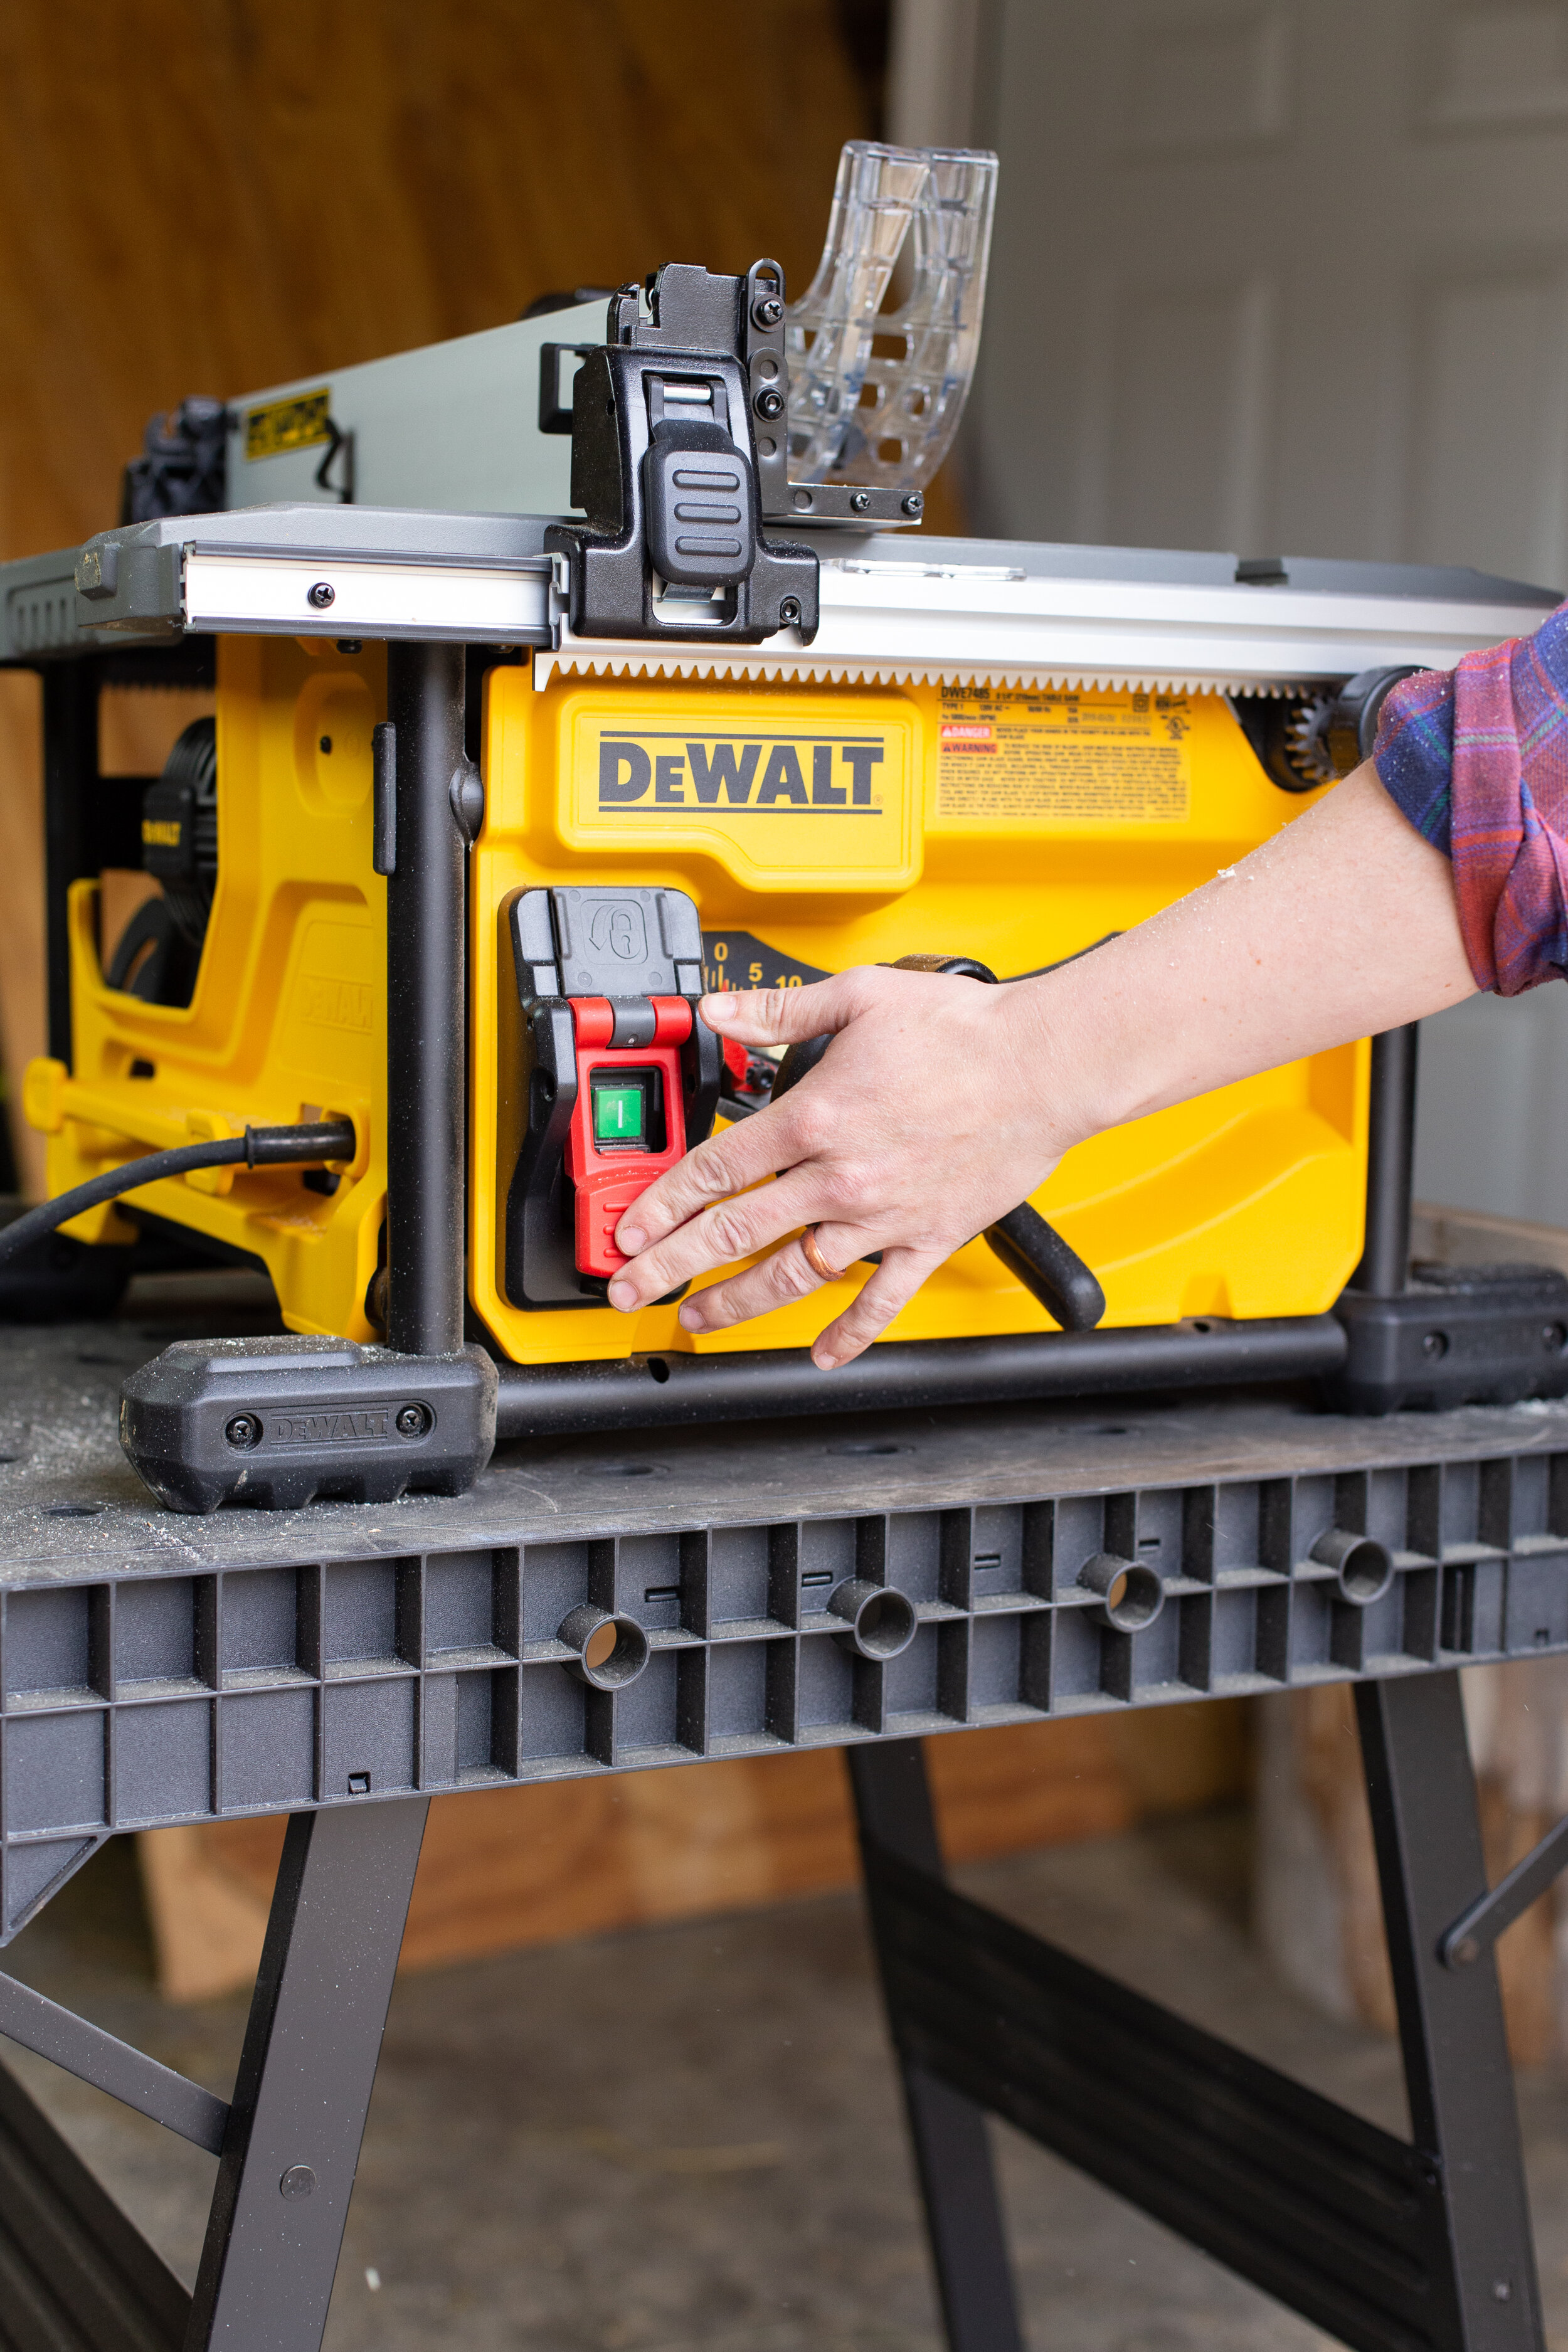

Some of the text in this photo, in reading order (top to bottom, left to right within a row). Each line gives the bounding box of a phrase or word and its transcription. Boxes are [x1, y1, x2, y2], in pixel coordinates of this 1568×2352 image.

[951, 726, 990, 738] DANGER
[952, 744, 996, 753] WARNING
[598, 741, 884, 805] DEWALT
[714, 942, 728, 961] 0
[748, 962, 763, 982] 5
[270, 1413, 388, 1443] DEWALT
